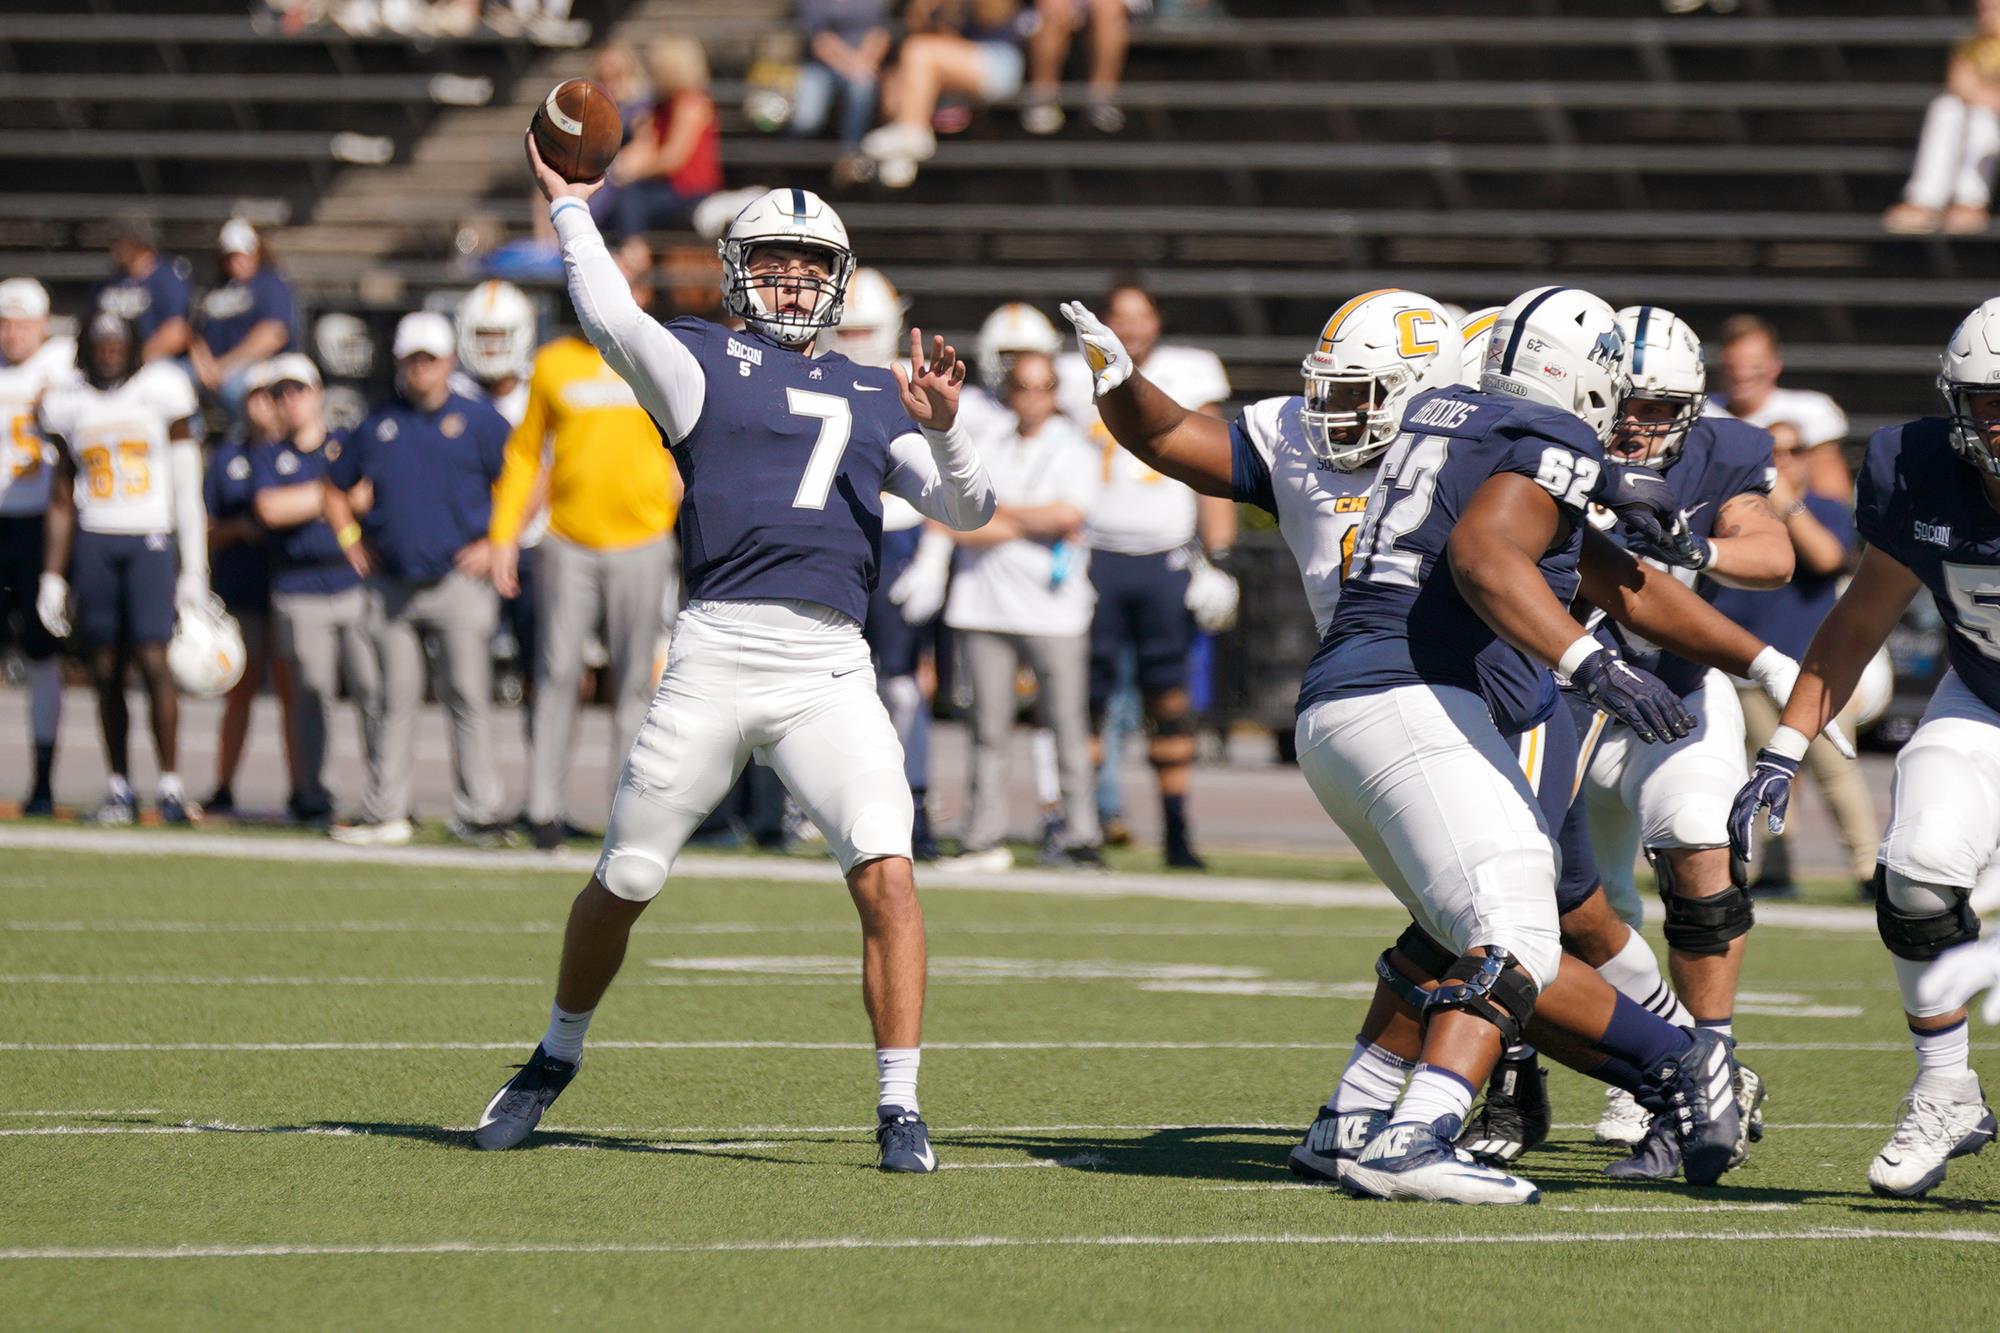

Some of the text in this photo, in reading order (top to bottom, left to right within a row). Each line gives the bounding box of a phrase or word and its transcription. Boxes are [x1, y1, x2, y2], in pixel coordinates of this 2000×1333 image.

[727, 337, 762, 366] SOCON
[1393, 308, 1439, 359] C
[1526, 338, 1544, 352] 62
[82, 439, 150, 499] 85
[786, 387, 852, 511] 7
[1534, 447, 1601, 510] 62
[1348, 432, 1450, 588] 62
[1914, 520, 1951, 547] SOCON
[1305, 1115, 1371, 1153] NIKE
[1356, 1126, 1415, 1164] NIKE
